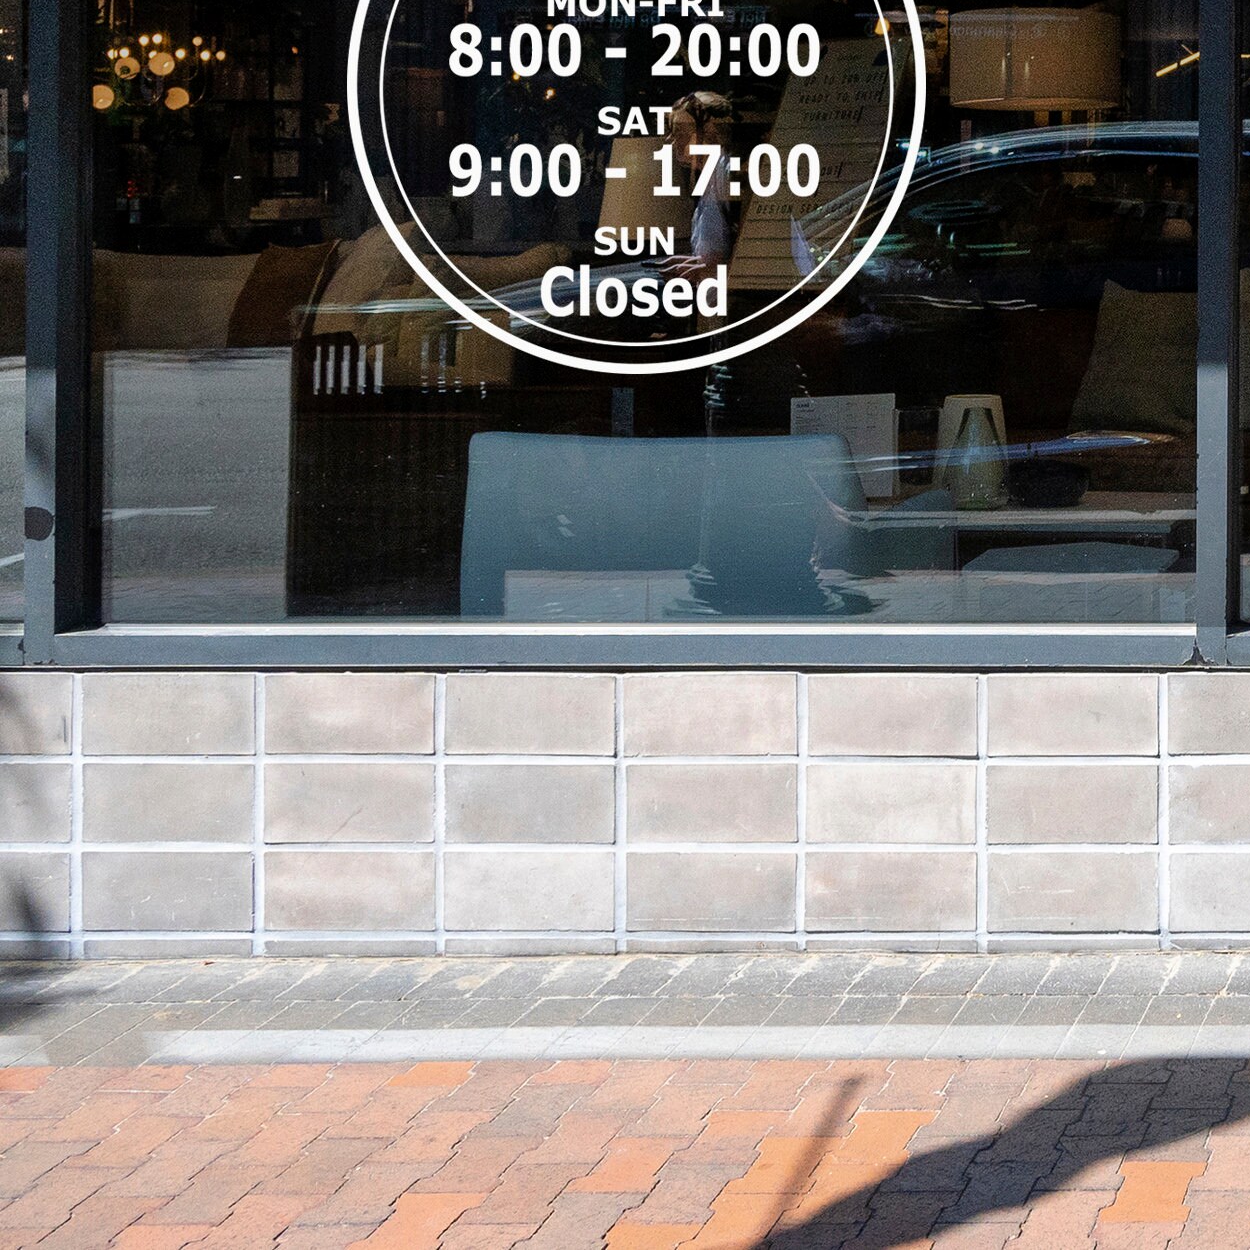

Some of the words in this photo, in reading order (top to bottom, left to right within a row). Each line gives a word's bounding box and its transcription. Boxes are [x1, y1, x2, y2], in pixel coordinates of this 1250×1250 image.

[448, 23, 582, 77] 8:00
[605, 47, 627, 58] -
[651, 23, 820, 77] 20:00
[597, 106, 673, 136] SAT
[448, 143, 582, 197] 9:00
[605, 167, 627, 179] -
[653, 143, 820, 197] 17:00
[594, 226, 674, 256] SUN
[540, 264, 728, 318] Closed
